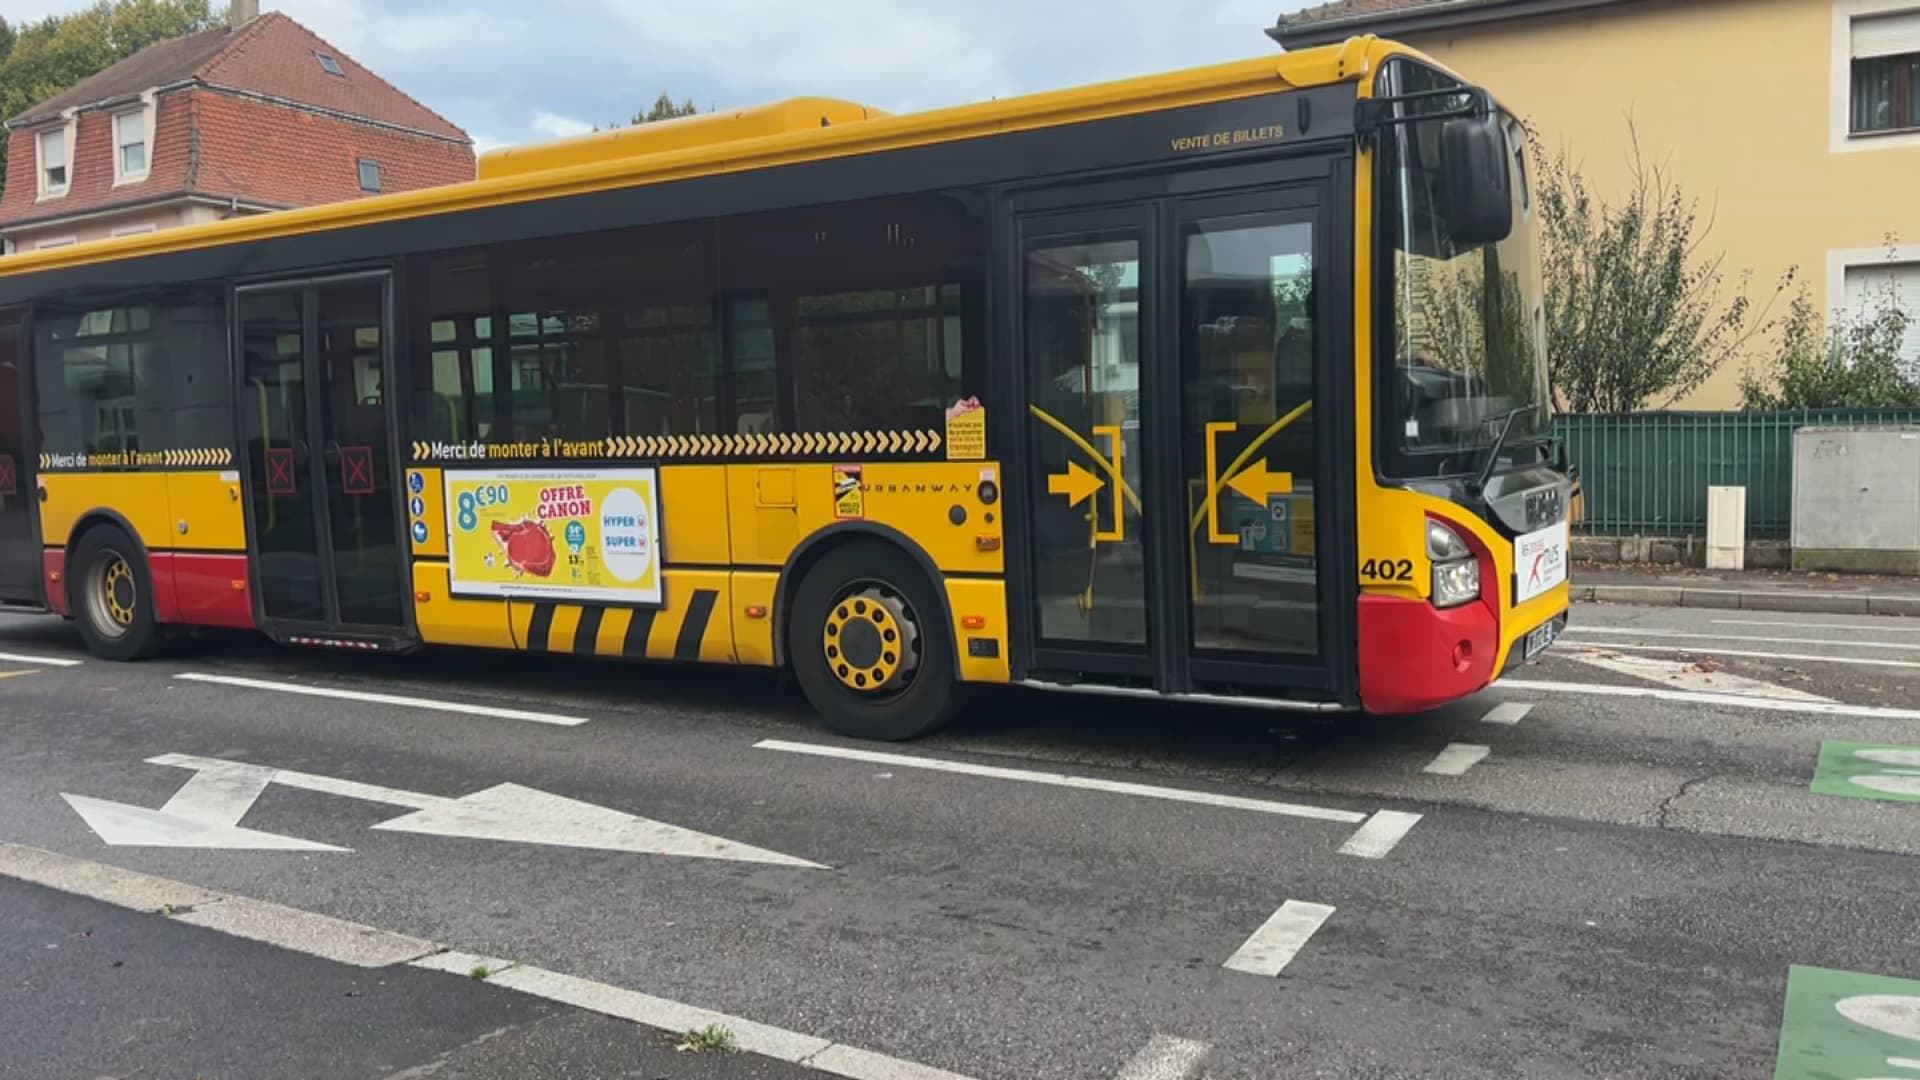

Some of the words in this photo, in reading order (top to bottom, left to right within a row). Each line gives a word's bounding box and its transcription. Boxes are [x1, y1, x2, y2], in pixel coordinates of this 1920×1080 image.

[1171, 134, 1211, 151] VENTE
[1213, 132, 1231, 146] DE
[1233, 125, 1283, 143] BILLETS
[51, 453, 75, 468] Merci
[76, 452, 87, 467] de
[88, 453, 121, 467] monter
[123, 449, 129, 465] à
[130, 450, 163, 465] l'avant
[432, 441, 466, 460] Merci
[469, 441, 486, 459] de
[488, 442, 541, 458] monter
[542, 438, 551, 458] à
[553, 438, 604, 457] l'avant
[540, 485, 585, 503] OFFRE
[537, 500, 591, 519] CANON
[603, 515, 636, 528] HYPER
[605, 535, 637, 548] SUPER
[1360, 558, 1414, 582] 402
